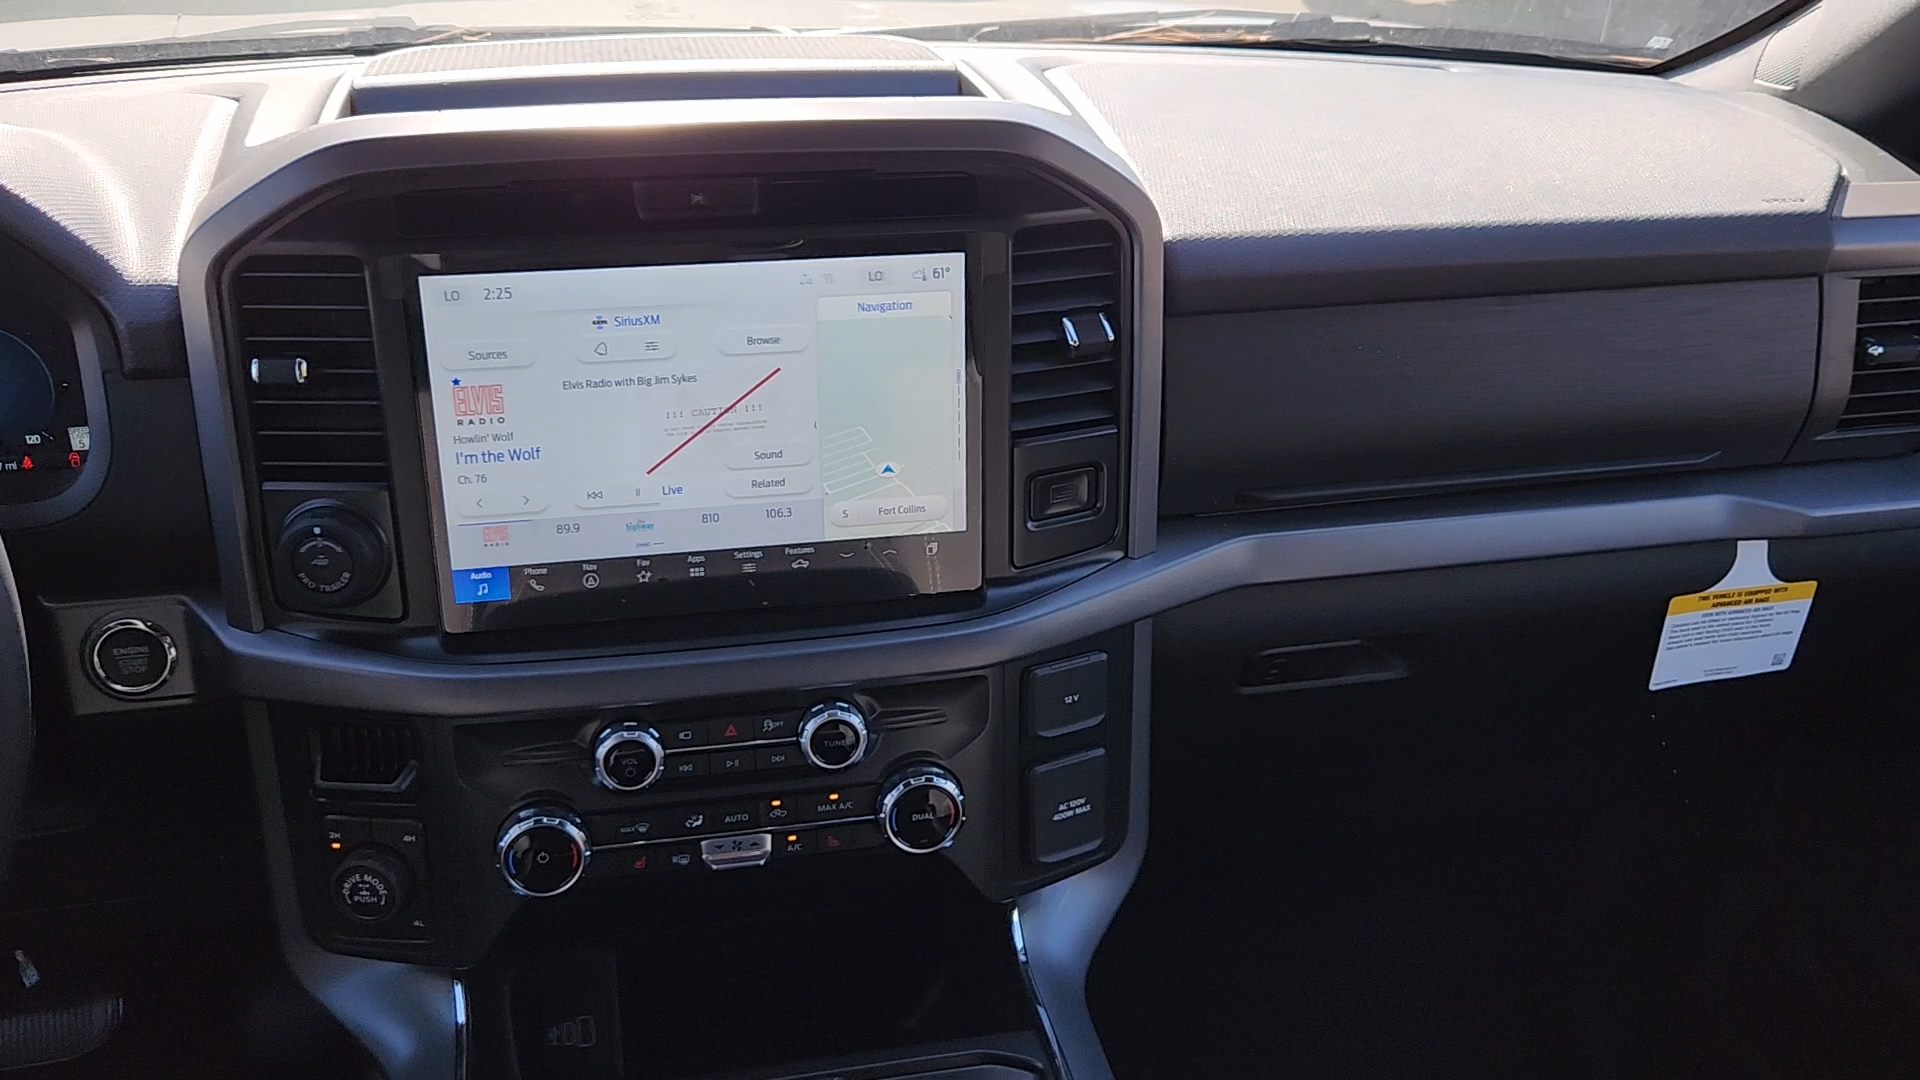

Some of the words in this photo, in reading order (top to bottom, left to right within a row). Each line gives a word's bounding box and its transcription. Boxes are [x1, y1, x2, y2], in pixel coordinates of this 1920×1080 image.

[868, 271, 883, 281] LO
[443, 290, 460, 302] LO
[483, 287, 513, 301] 2:25
[857, 300, 912, 313] Navigation
[614, 314, 661, 327] SiriusXM
[746, 336, 781, 346] Browse
[468, 350, 508, 361] Sources
[562, 379, 584, 390] Elvis
[586, 377, 611, 389] Radio
[613, 376, 635, 388] with
[637, 375, 652, 389] Big
[653, 374, 670, 387] Jim
[671, 373, 698, 387] Sykes
[453, 384, 505, 417] ELVIS
[457, 416, 506, 426] RADIO
[25, 434, 41, 444] 120
[79, 440, 85, 448] 5
[453, 433, 490, 445] Howlin'
[492, 432, 514, 443] Wolf
[455, 451, 479, 465] I'm
[481, 449, 505, 463] the
[508, 447, 541, 461] Wolf
[754, 450, 783, 461] Sound
[5, 460, 18, 471] mi
[457, 475, 473, 485] Ch.
[475, 473, 488, 484] 76
[751, 478, 786, 489] Related
[662, 486, 683, 496] Live
[765, 508, 793, 519] 106.3
[842, 509, 849, 519] S
[878, 505, 896, 516] Fort
[898, 503, 927, 515] Collins
[701, 513, 720, 524] 810
[556, 523, 581, 535] 89.9
[734, 549, 764, 560] Settings
[785, 546, 815, 556] Features
[637, 558, 650, 567] Fav
[687, 555, 705, 564] Apps
[524, 566, 548, 576] Phone
[583, 563, 598, 572] Nav
[470, 571, 493, 580] Audio
[298, 572, 315, 589] PRO
[319, 571, 351, 592] TRAILER
[1064, 695, 1073, 704] 12
[772, 719, 785, 728] OFF
[823, 739, 849, 748] TUNE
[621, 757, 639, 766] VOL
[817, 803, 836, 813] MAX
[837, 801, 854, 811] A/C
[1058, 801, 1069, 811] AC
[1069, 797, 1087, 808] 120V
[911, 812, 935, 822] DUAL
[1052, 810, 1075, 821] 400W
[1075, 804, 1092, 815] MAX
[724, 814, 749, 824] AUTO
[787, 843, 803, 852] A/C
[342, 874, 361, 895] DRIVE
[363, 874, 388, 895] MODE
[354, 895, 378, 904] PUSH
